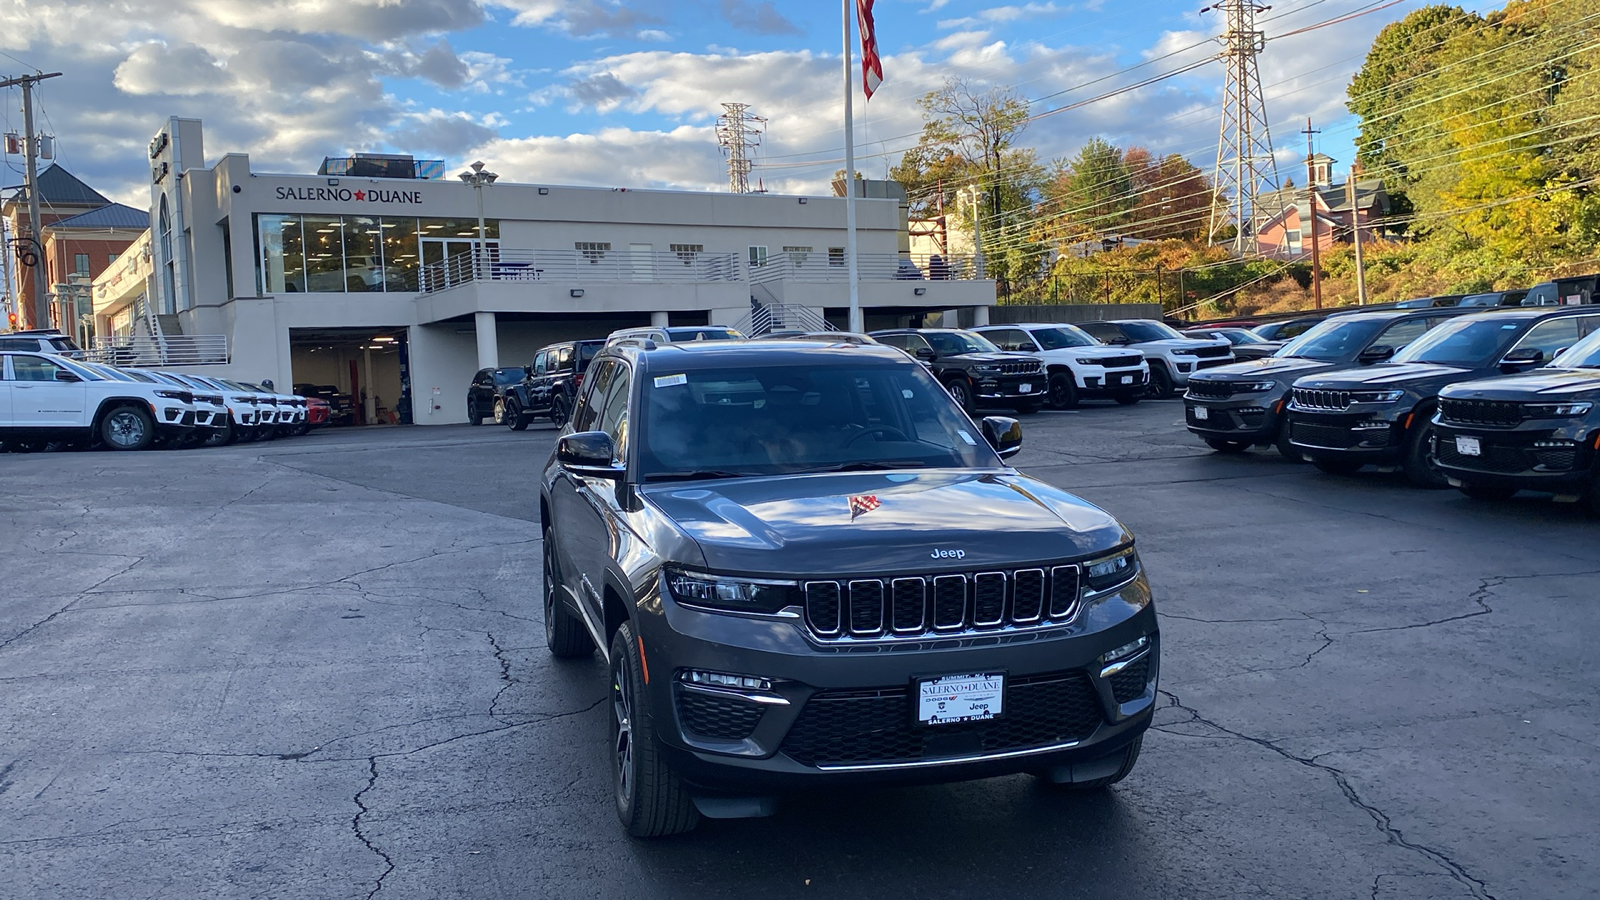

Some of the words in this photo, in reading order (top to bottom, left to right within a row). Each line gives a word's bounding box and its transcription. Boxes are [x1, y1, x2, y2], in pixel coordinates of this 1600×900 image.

[276, 187, 352, 202] SALERNO
[368, 190, 422, 204] DUANE
[930, 548, 966, 560] Jeep
[922, 685, 963, 695] SALERNO
[968, 682, 999, 691] DUANE
[928, 717, 961, 725] SALERNO
